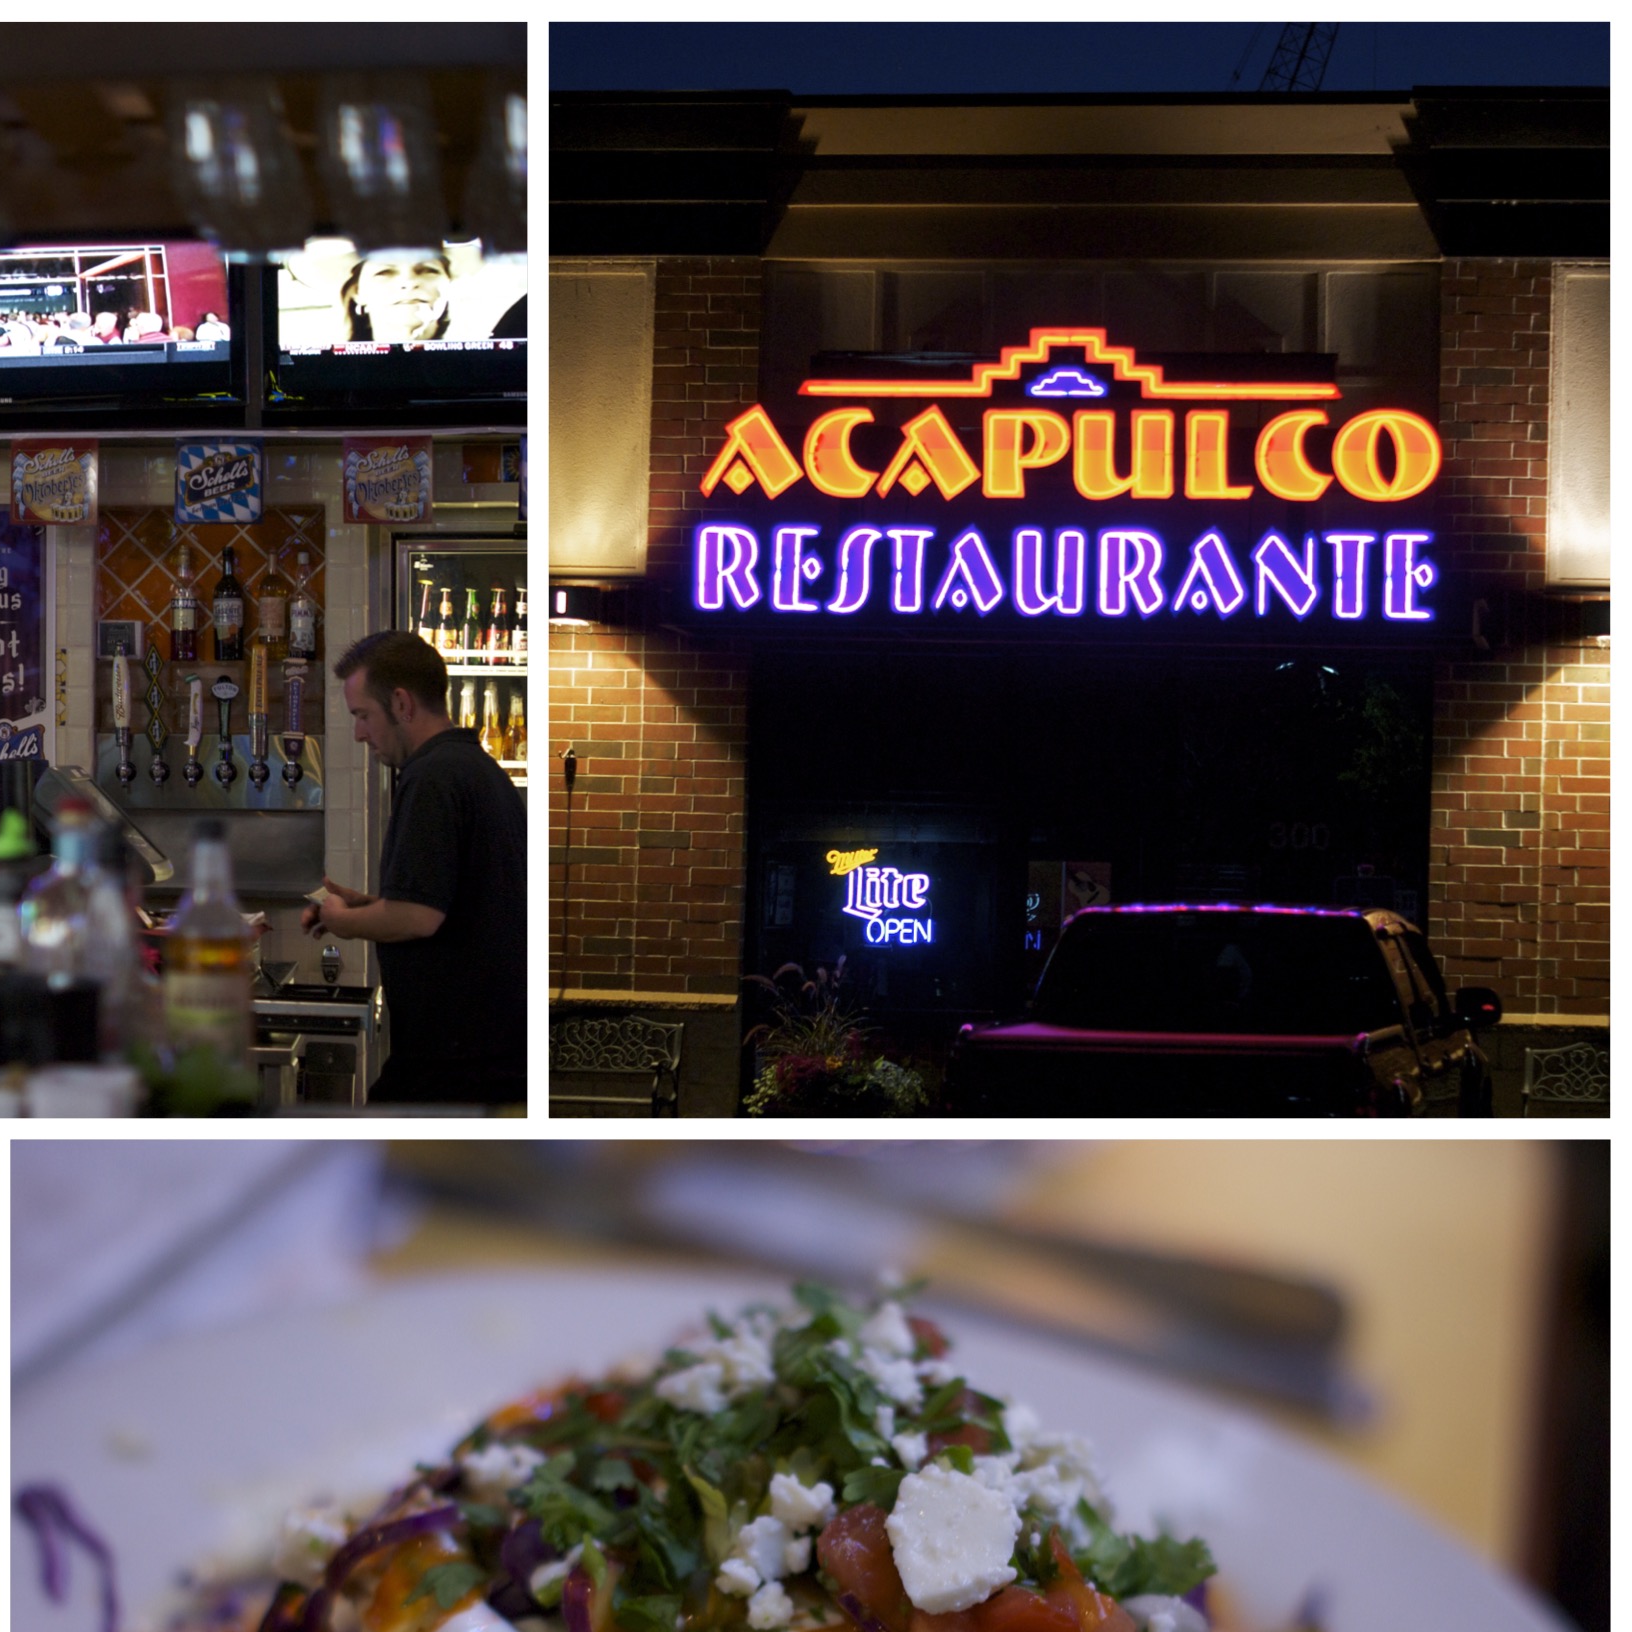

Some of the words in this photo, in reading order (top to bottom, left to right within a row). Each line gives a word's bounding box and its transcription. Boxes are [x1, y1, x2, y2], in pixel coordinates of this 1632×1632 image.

[424, 342, 463, 351] BOWLING
[465, 341, 494, 350] GREEN
[698, 403, 1443, 502] ACAPULCO
[204, 481, 236, 497] BEER
[693, 524, 1436, 620] RESTAURANTE
[842, 866, 930, 920] Lite
[866, 918, 932, 944] OPEN
